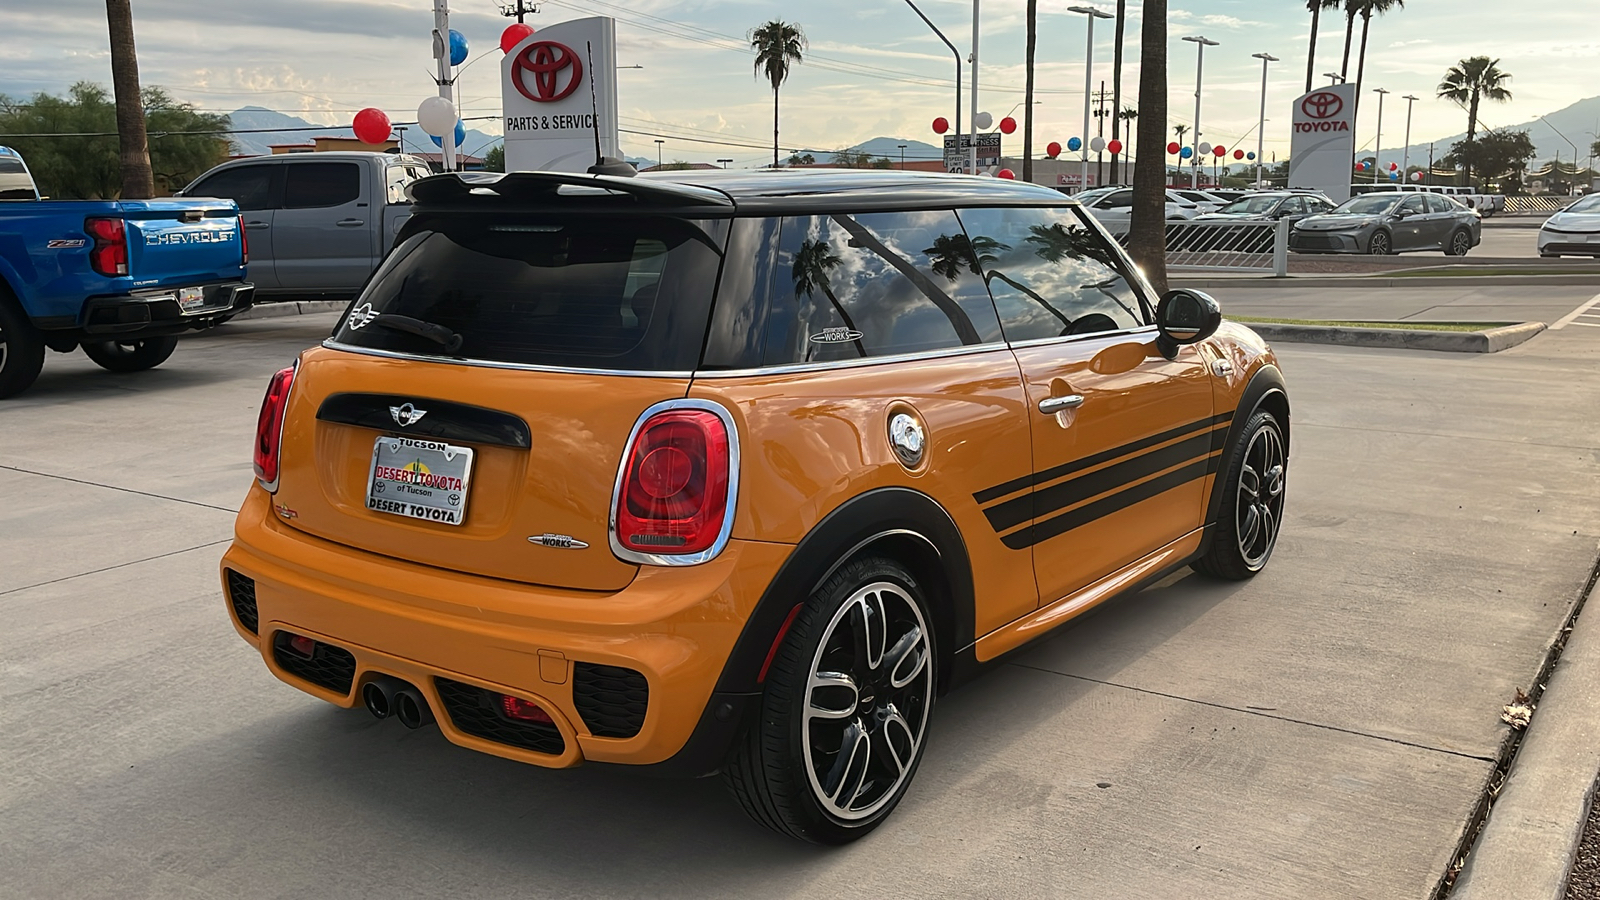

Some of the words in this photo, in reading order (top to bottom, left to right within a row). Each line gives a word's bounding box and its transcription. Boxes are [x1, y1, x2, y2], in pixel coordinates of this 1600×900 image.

[507, 117, 539, 131] PARTS
[541, 115, 550, 130] &
[1293, 121, 1349, 133] TOYOTA
[944, 140, 968, 148] CHZE
[948, 166, 963, 174] 40
[145, 231, 235, 246] CHEVROLET
[824, 332, 850, 341] WORKS
[400, 438, 446, 451] TUCSON
[376, 466, 416, 483] DESERT
[419, 472, 462, 491] TOYOTA
[396, 485, 405, 493] of
[406, 485, 433, 497] Tucson
[369, 498, 407, 514] DESERT
[410, 505, 455, 523] TOYOTA
[542, 537, 572, 548] WORKS
